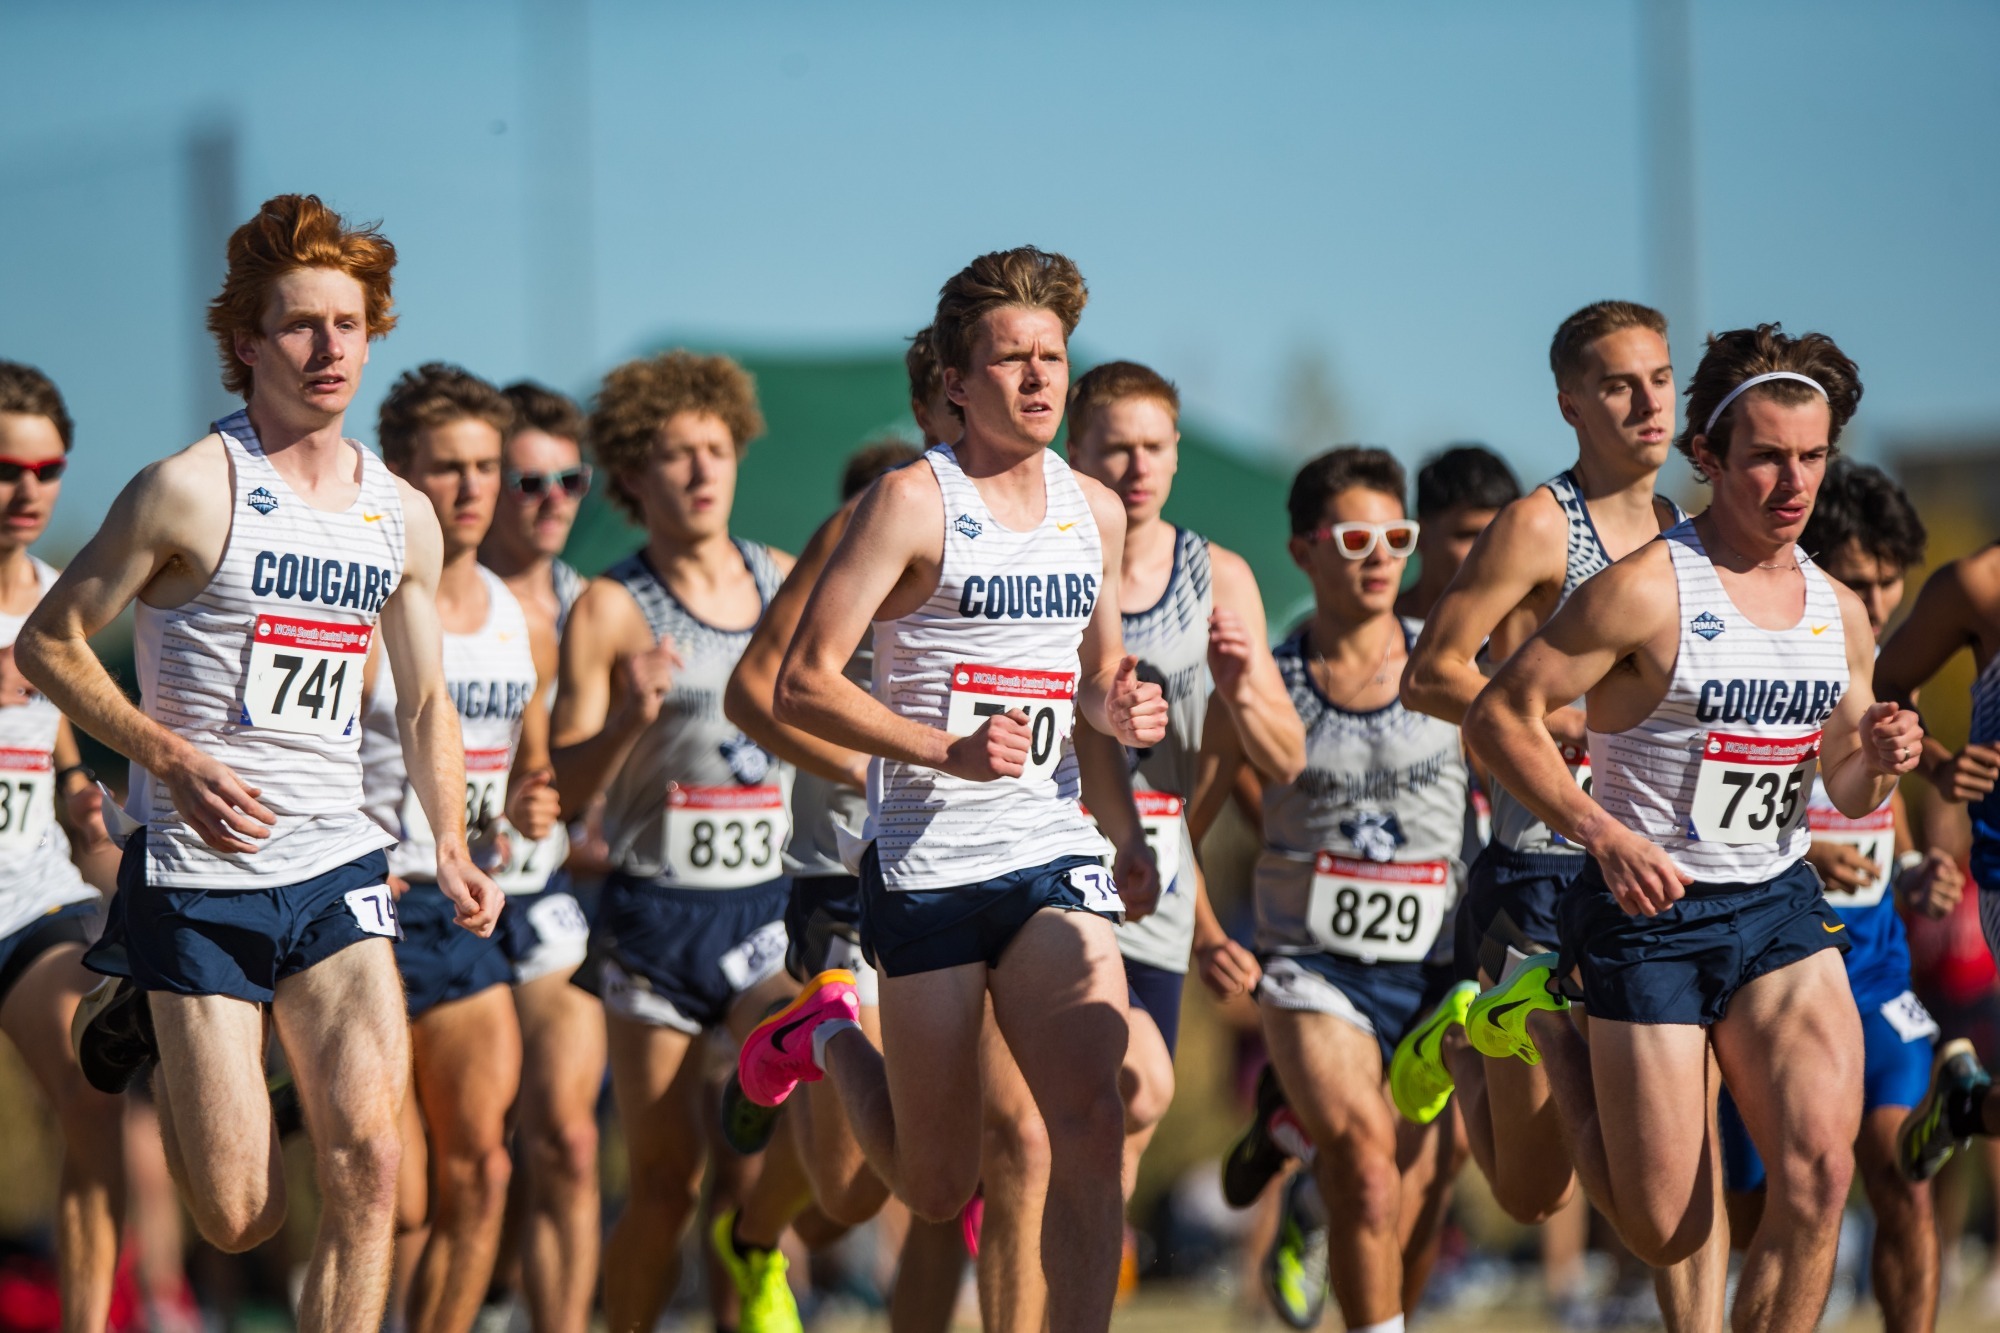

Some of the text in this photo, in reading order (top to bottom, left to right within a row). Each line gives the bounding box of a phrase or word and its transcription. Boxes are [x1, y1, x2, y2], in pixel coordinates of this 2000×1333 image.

[249, 493, 278, 508] RMAC
[956, 520, 983, 533] RMAC
[251, 551, 391, 613] COUGARS
[959, 573, 1096, 619] COUGARS
[274, 623, 297, 637] NCAA
[297, 626, 319, 640] South
[320, 629, 341, 642] Central
[1692, 620, 1725, 633] RMAC
[271, 654, 347, 720] 741
[447, 681, 531, 720] UGARS
[973, 672, 997, 685] NCAA
[997, 674, 1021, 687] South
[1021, 677, 1044, 689] Central
[1696, 679, 1840, 725] COUGARS
[974, 702, 1055, 765] 70
[1724, 741, 1748, 754] NCAA
[1749, 743, 1773, 756] South
[0, 781, 34, 832] 37
[1719, 770, 1804, 830] 735
[690, 820, 772, 868] 833
[361, 893, 395, 927] 74
[1331, 889, 1421, 943] 829
